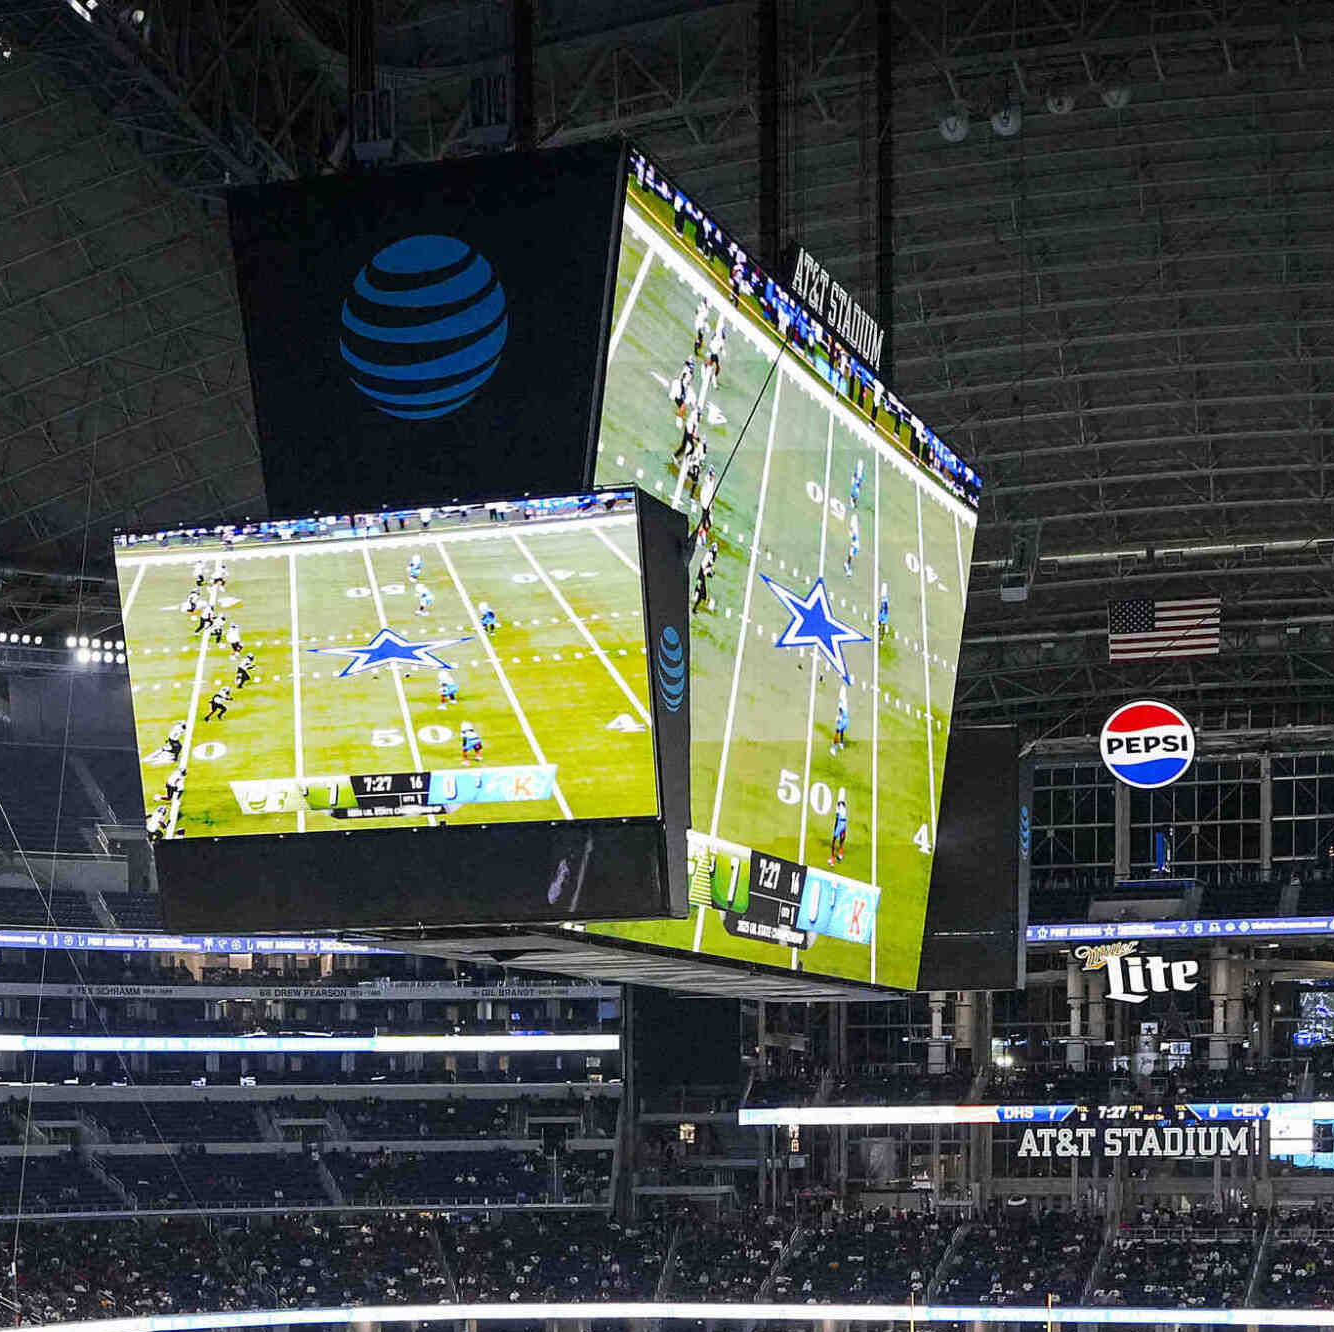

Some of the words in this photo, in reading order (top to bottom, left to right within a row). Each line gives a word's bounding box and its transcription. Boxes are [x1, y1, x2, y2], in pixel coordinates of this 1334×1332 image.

[791, 247, 830, 324] AT&T
[827, 281, 885, 371] STADIUM
[1106, 733, 1189, 756] PEPSI
[363, 776, 392, 792] 7:27
[410, 775, 423, 789] 16
[776, 768, 833, 816] 50
[757, 859, 781, 891] 7:27
[790, 870, 801, 895] 16
[1074, 940, 1140, 972] Miller
[274, 988, 301, 998] DREW
[1105, 955, 1199, 1004] Lite
[1003, 1105, 1034, 1120] DHS
[1047, 1105, 1057, 1120] 7
[1098, 1105, 1128, 1120] 7:27
[1017, 1127, 1097, 1158] AT&T
[1103, 1126, 1250, 1157] STADIUM
